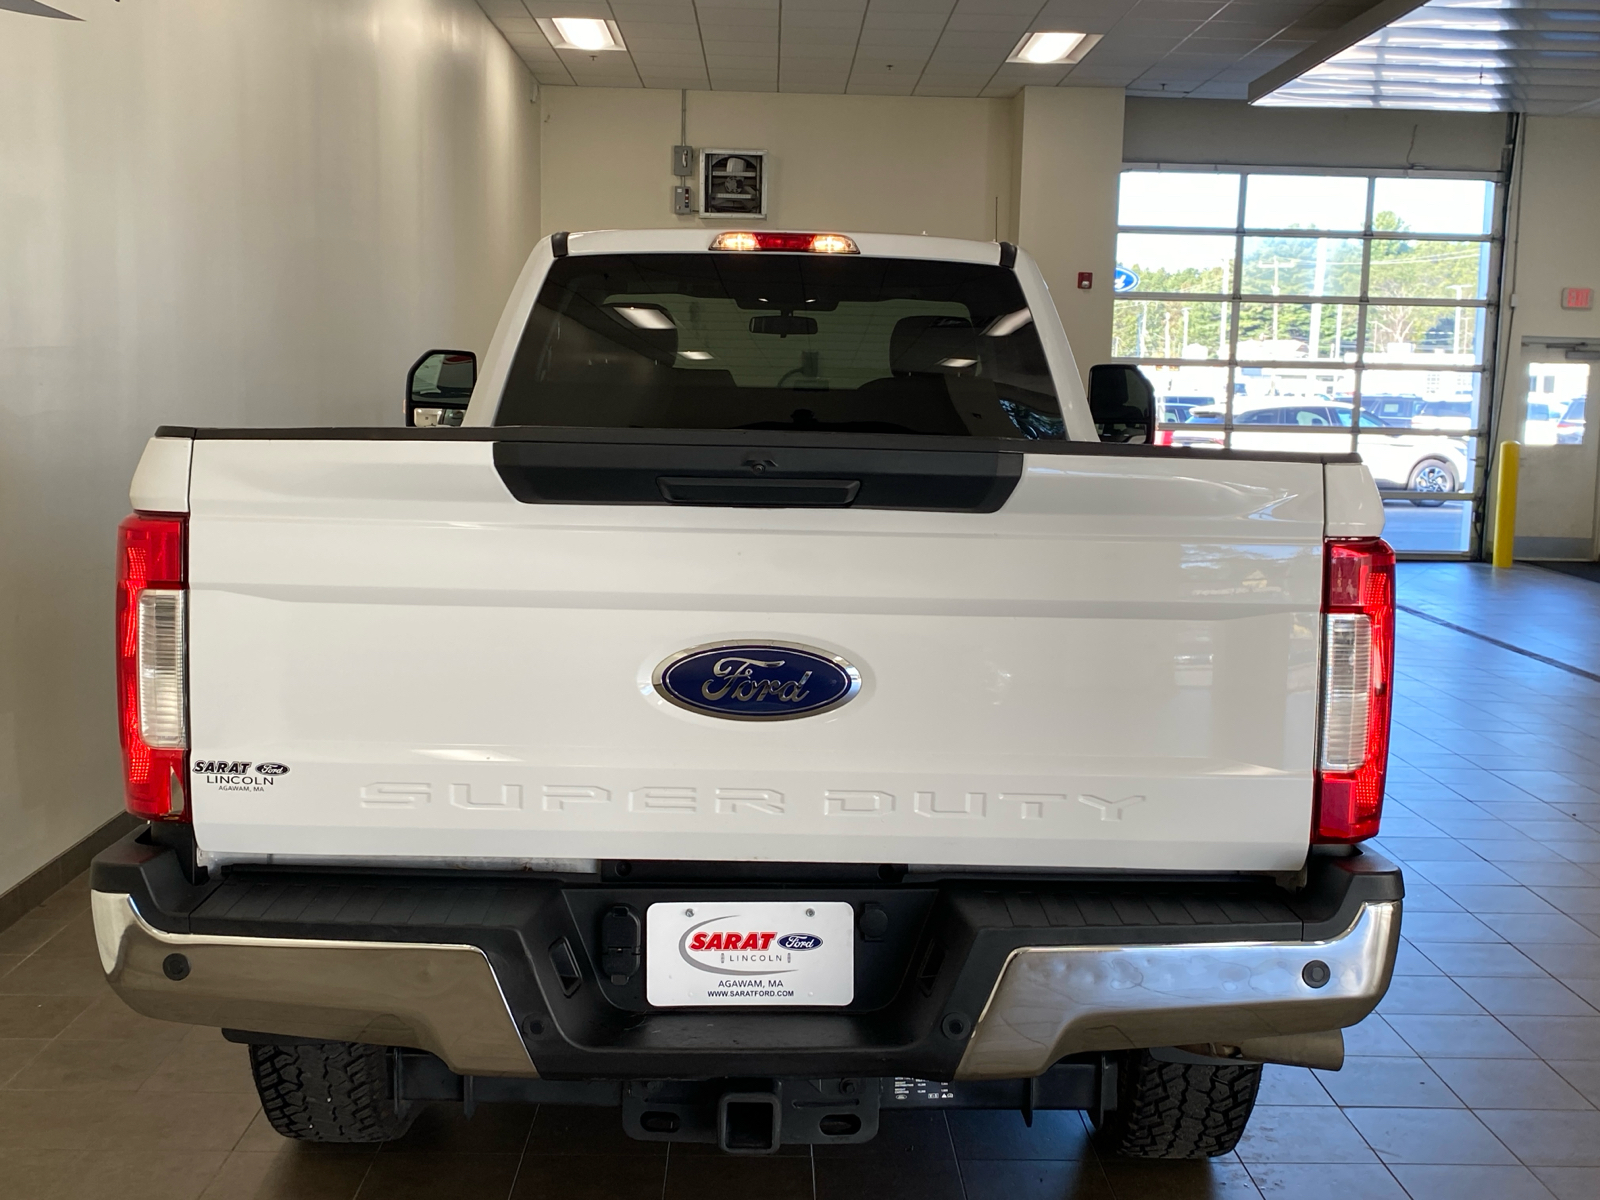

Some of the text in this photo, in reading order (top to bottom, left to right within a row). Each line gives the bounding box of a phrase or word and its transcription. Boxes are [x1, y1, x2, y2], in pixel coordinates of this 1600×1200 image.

[702, 656, 812, 702] Ford
[193, 760, 284, 775] SARAT Ford
[206, 775, 274, 785] LINCOLN
[360, 781, 1147, 822] SUPER DUTY
[689, 931, 815, 951] SARAT Ford
[729, 954, 783, 962] LINCOLN
[718, 979, 784, 989] AGAWAM, MA
[707, 989, 795, 998] WWW.SARATFORD.COM
